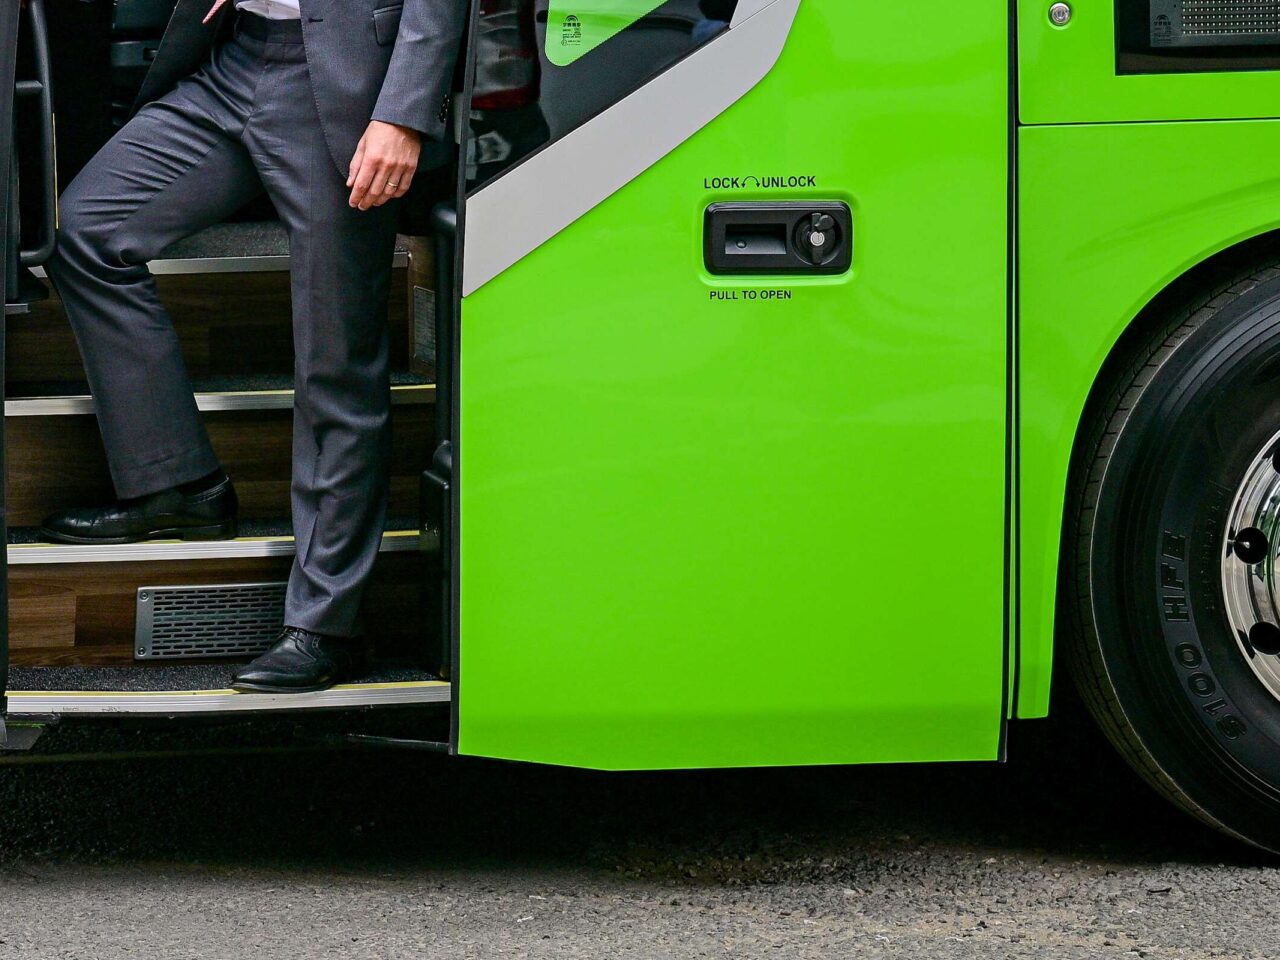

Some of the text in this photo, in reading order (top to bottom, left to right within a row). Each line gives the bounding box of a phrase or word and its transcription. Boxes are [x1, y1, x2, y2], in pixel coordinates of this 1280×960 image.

[704, 176, 816, 189] LOCK UNLOCK
[710, 289, 792, 300] PULL TO OPEN
